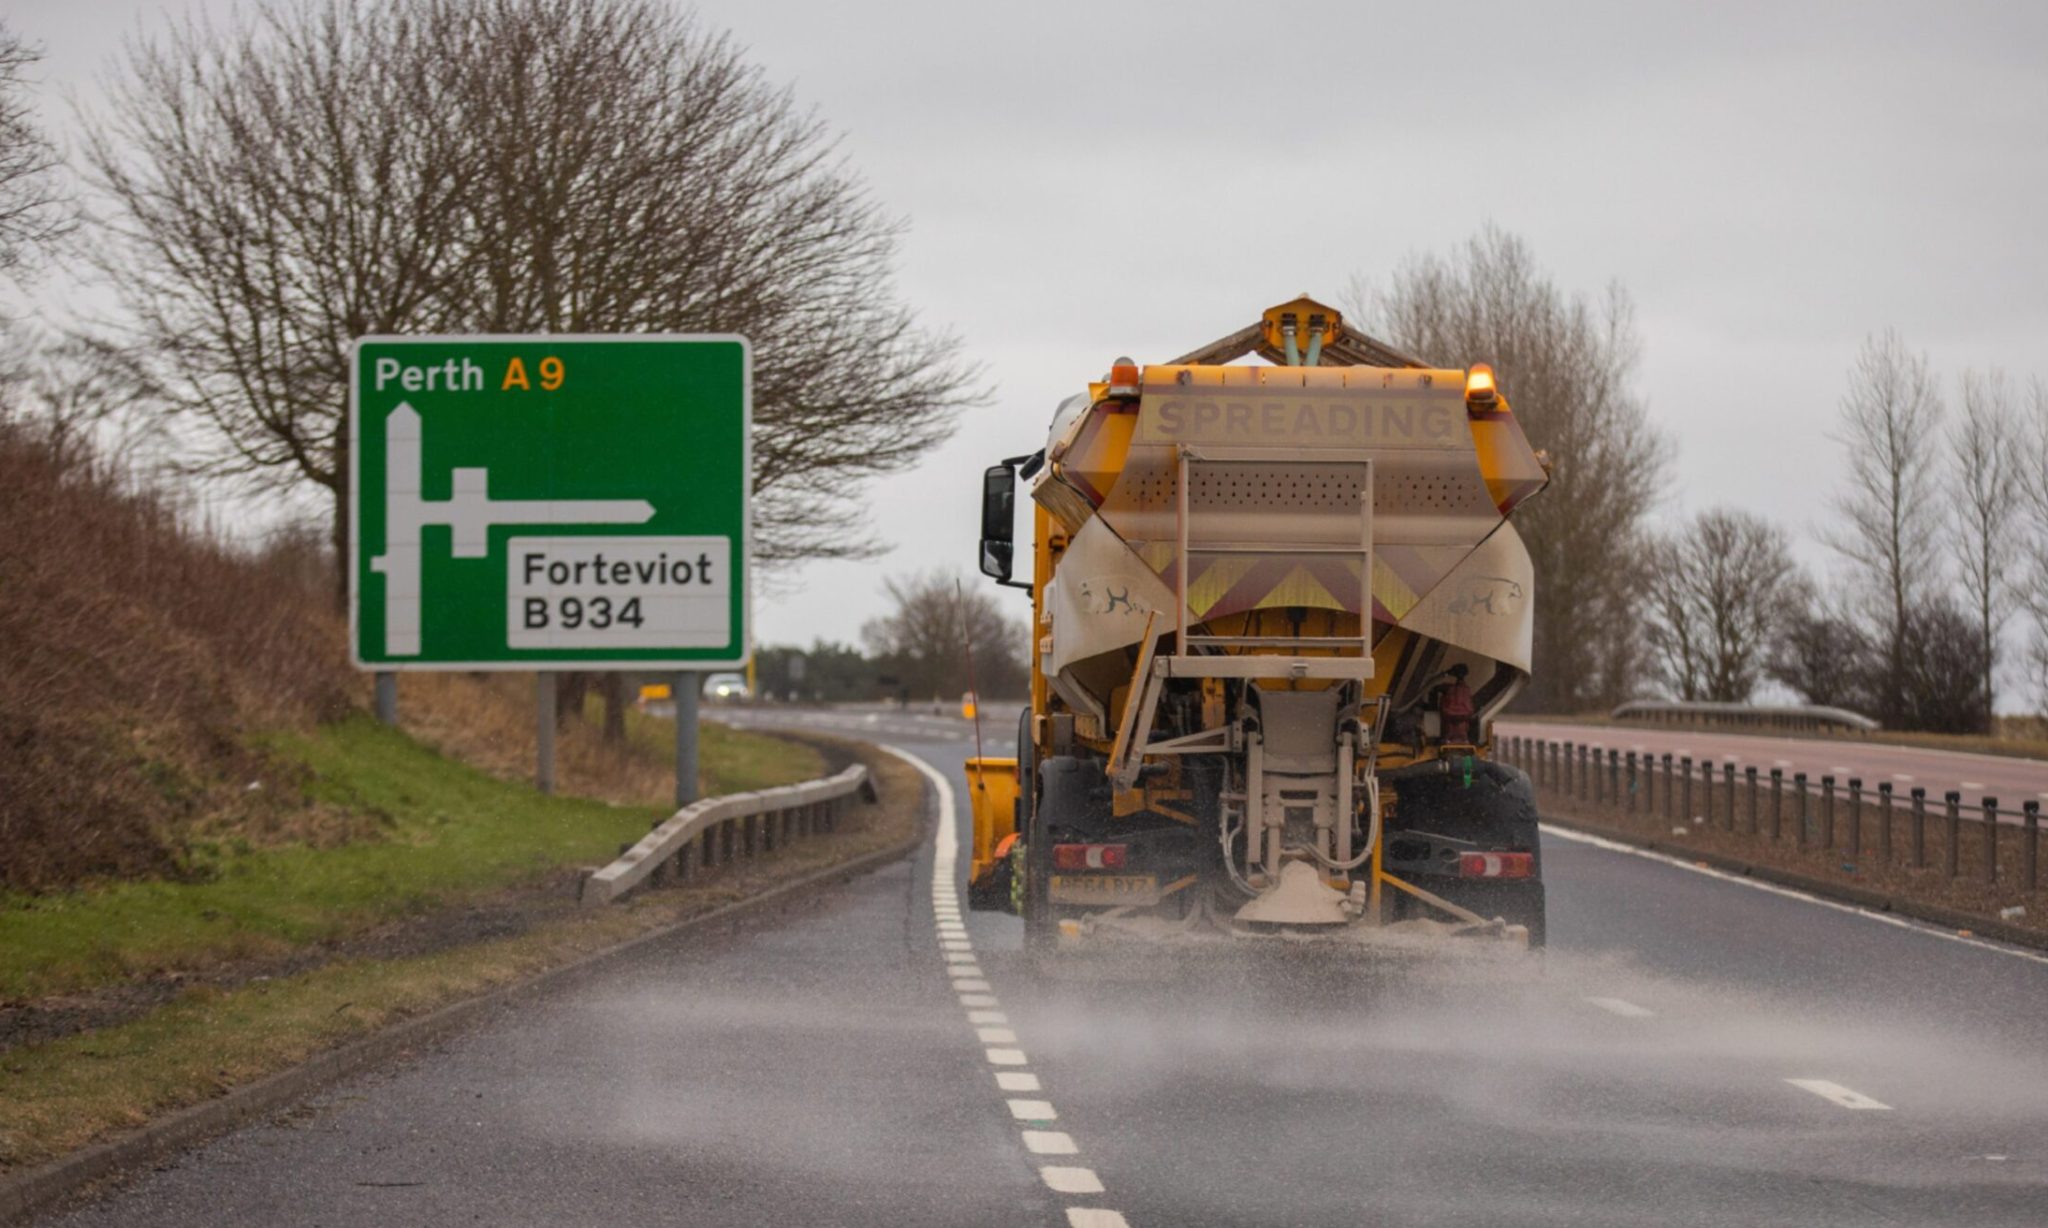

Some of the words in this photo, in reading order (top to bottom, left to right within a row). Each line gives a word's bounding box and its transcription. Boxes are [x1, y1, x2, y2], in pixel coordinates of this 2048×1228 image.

[375, 357, 484, 391] Perth
[1157, 400, 1453, 438] SPREADING
[523, 553, 713, 585] Forteviot
